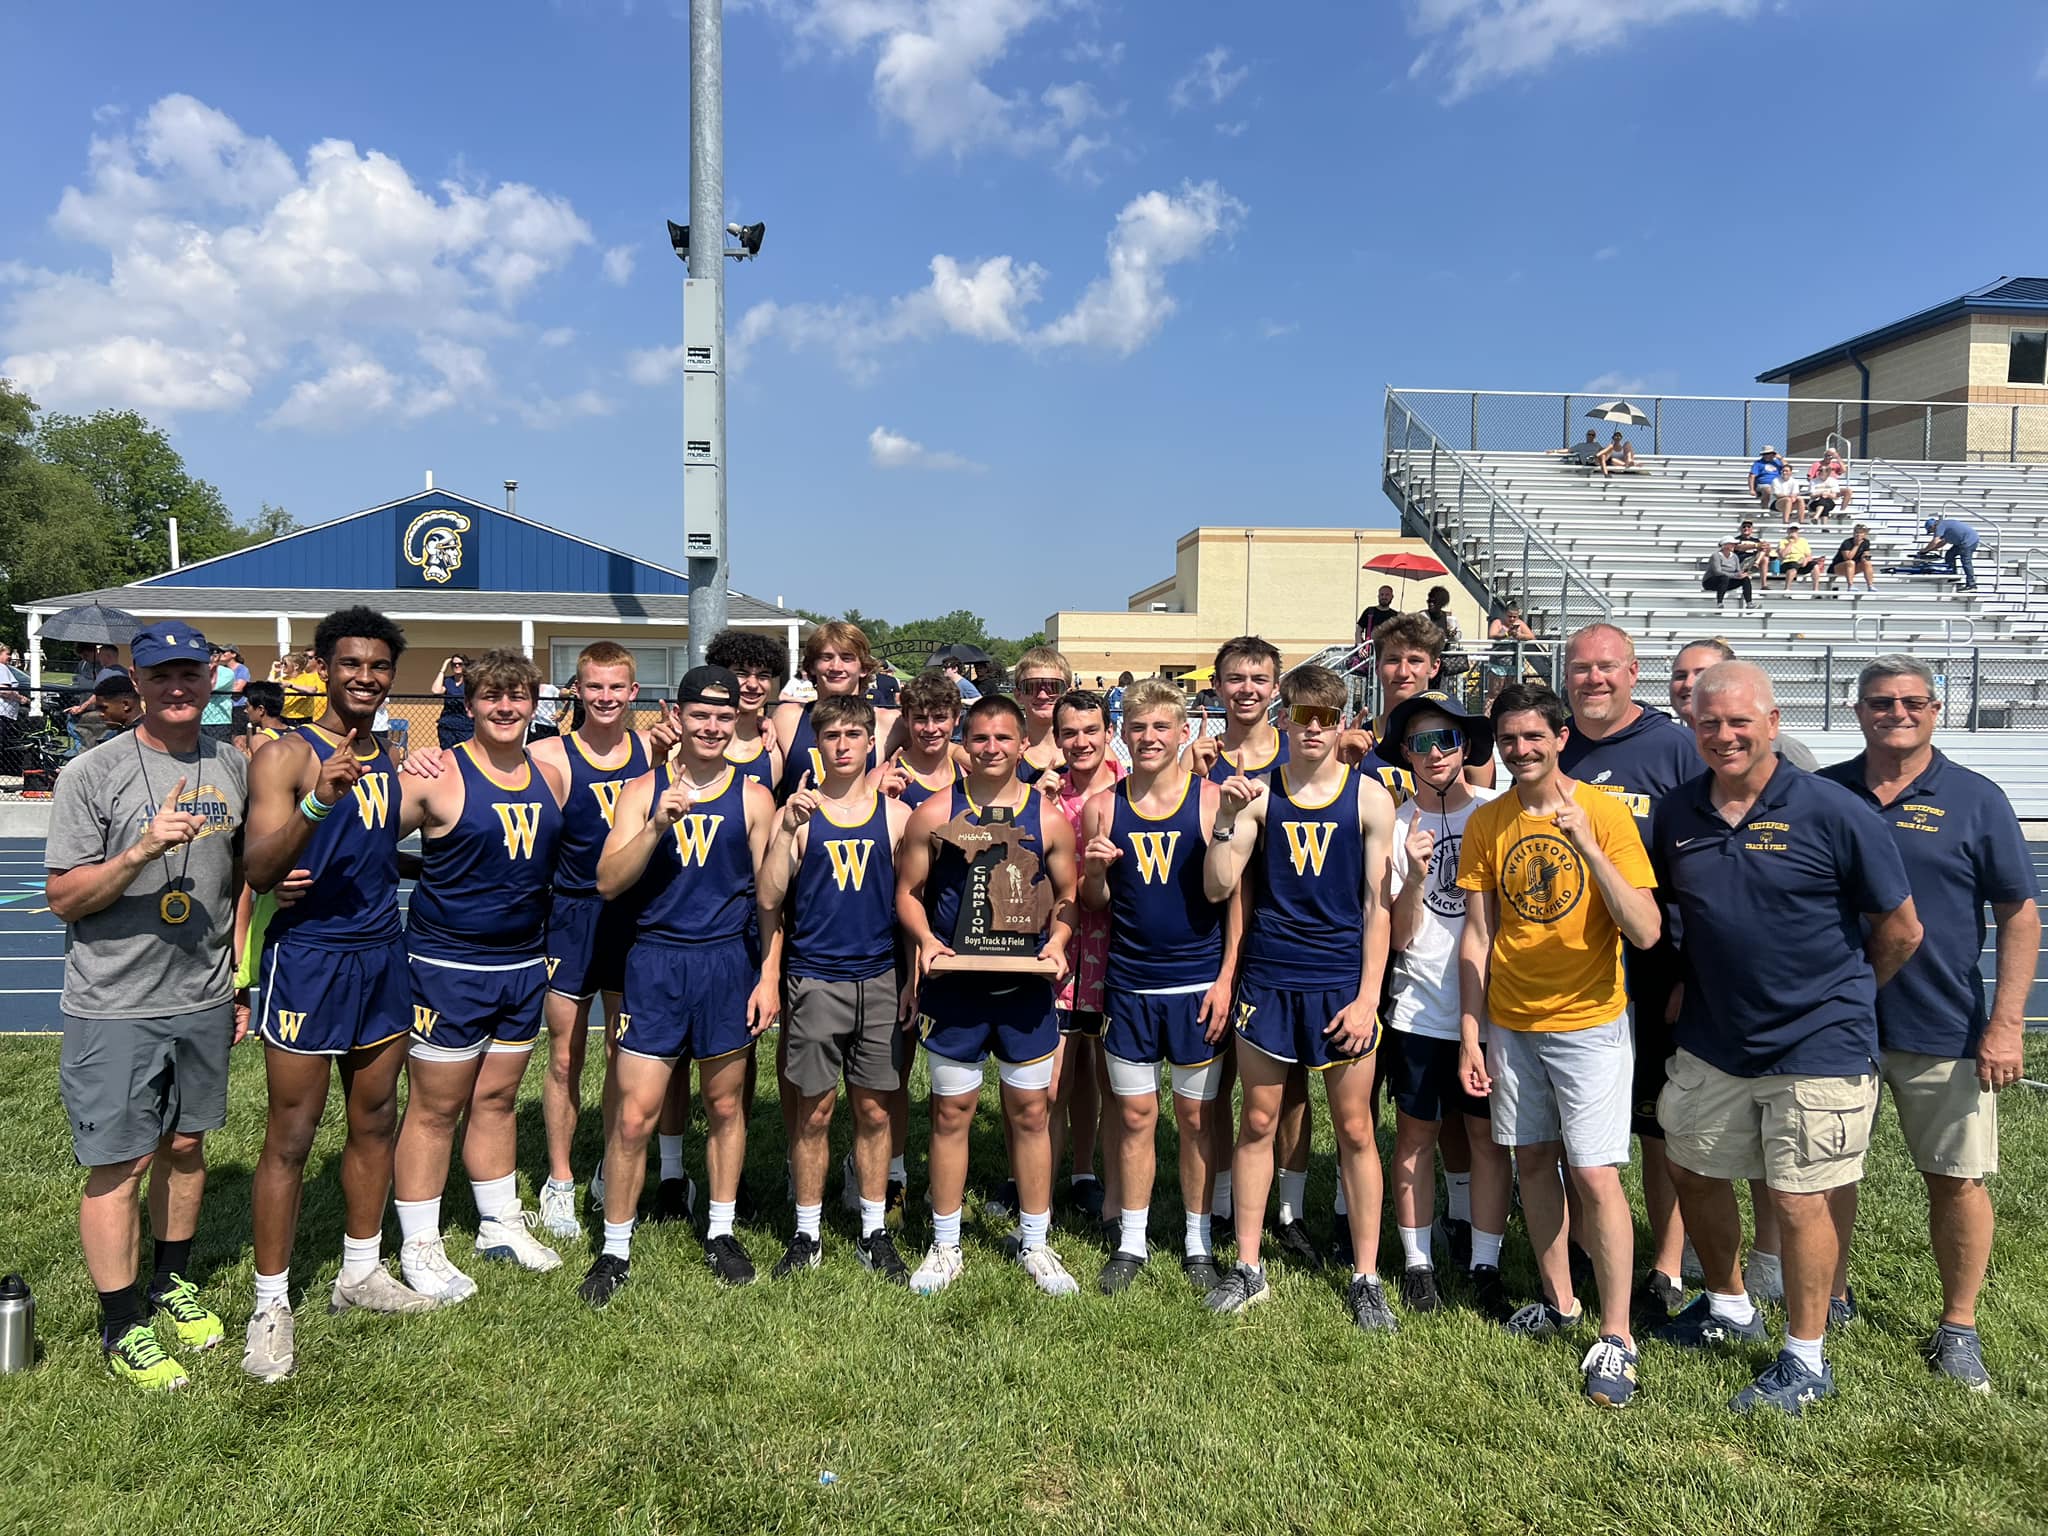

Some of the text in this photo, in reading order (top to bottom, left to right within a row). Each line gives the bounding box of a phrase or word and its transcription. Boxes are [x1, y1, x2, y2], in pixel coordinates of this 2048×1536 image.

[351, 772, 389, 830] W
[491, 803, 543, 860] W
[672, 813, 725, 867] W
[1747, 822, 1790, 831] WHITEFORD
[824, 839, 875, 891] W
[1128, 831, 1181, 884] W
[1282, 821, 1339, 876] W
[1508, 842, 1573, 875] WHITEFORD
[971, 865, 987, 934] CHAMPION
[1428, 890, 1457, 911] TRACK
[1514, 889, 1572, 916] TRACK FIELD
[1005, 915, 1031, 923] 2024
[964, 936, 981, 946] Boys
[982, 936, 1000, 945] Track
[1008, 937, 1025, 946] Field
[278, 1009, 307, 1042] W
[413, 1004, 440, 1038] W
